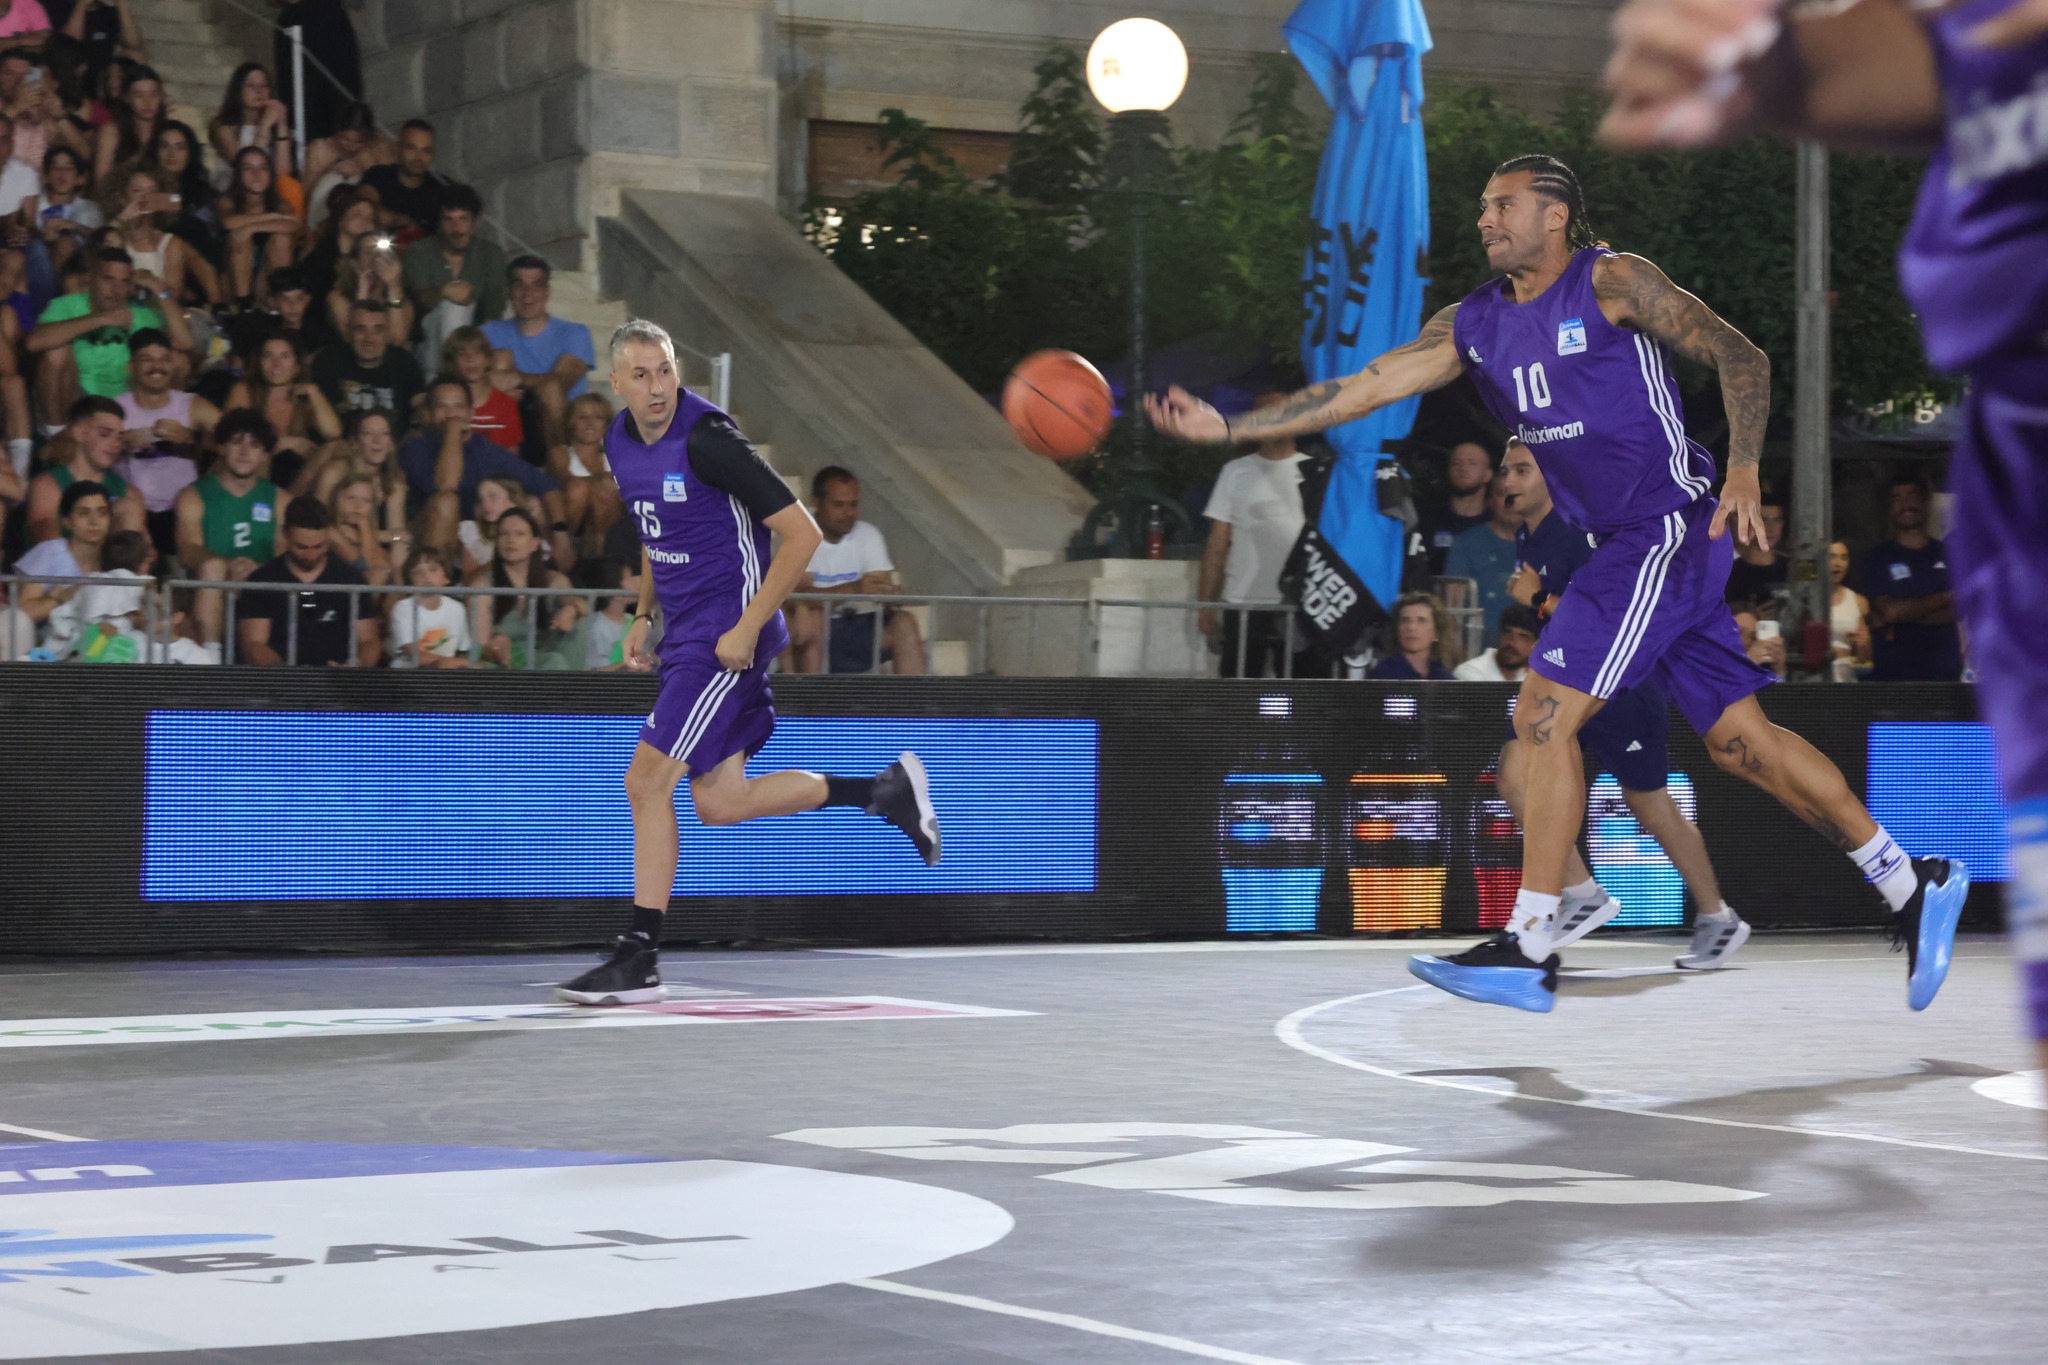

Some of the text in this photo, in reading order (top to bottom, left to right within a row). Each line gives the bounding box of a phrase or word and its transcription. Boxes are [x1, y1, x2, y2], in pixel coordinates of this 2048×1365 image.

[1512, 362, 1552, 412] 10
[634, 501, 662, 538] 15
[233, 522, 251, 547] 2
[645, 545, 690, 564] iximan
[0, 1012, 602, 1037] OSMOTE
